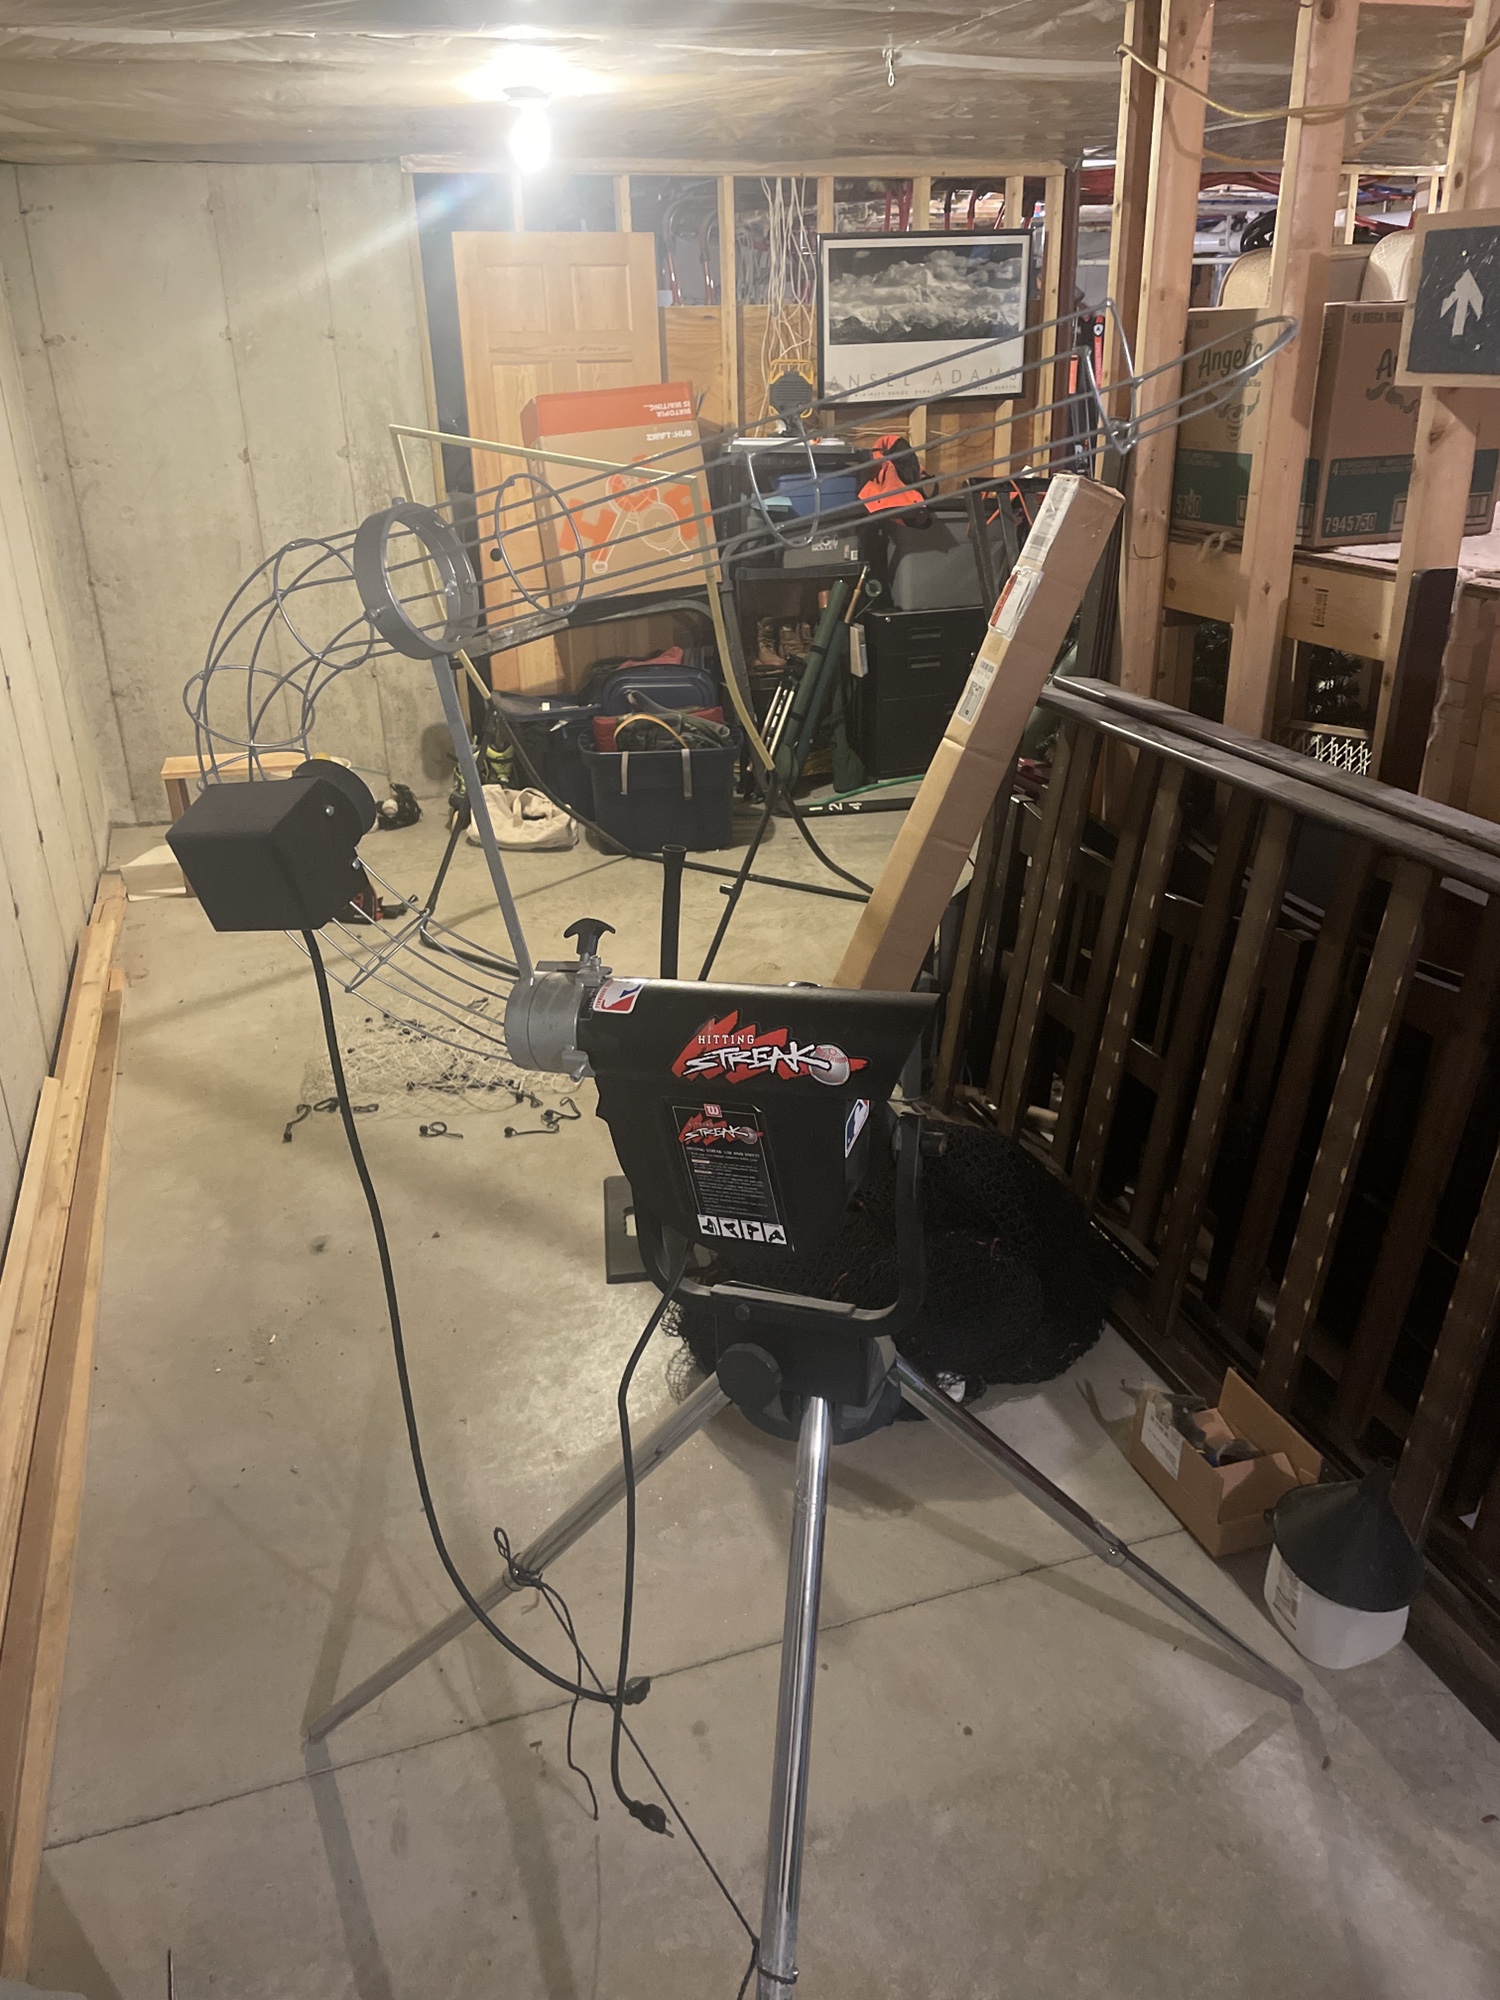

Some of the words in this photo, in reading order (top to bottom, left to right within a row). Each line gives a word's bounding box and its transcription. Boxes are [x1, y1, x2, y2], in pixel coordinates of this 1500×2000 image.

[829, 372, 910, 389] ANSEL
[698, 1034, 755, 1045] HITTING
[683, 1041, 831, 1076] STREAK
[684, 1125, 749, 1142] STREAK
